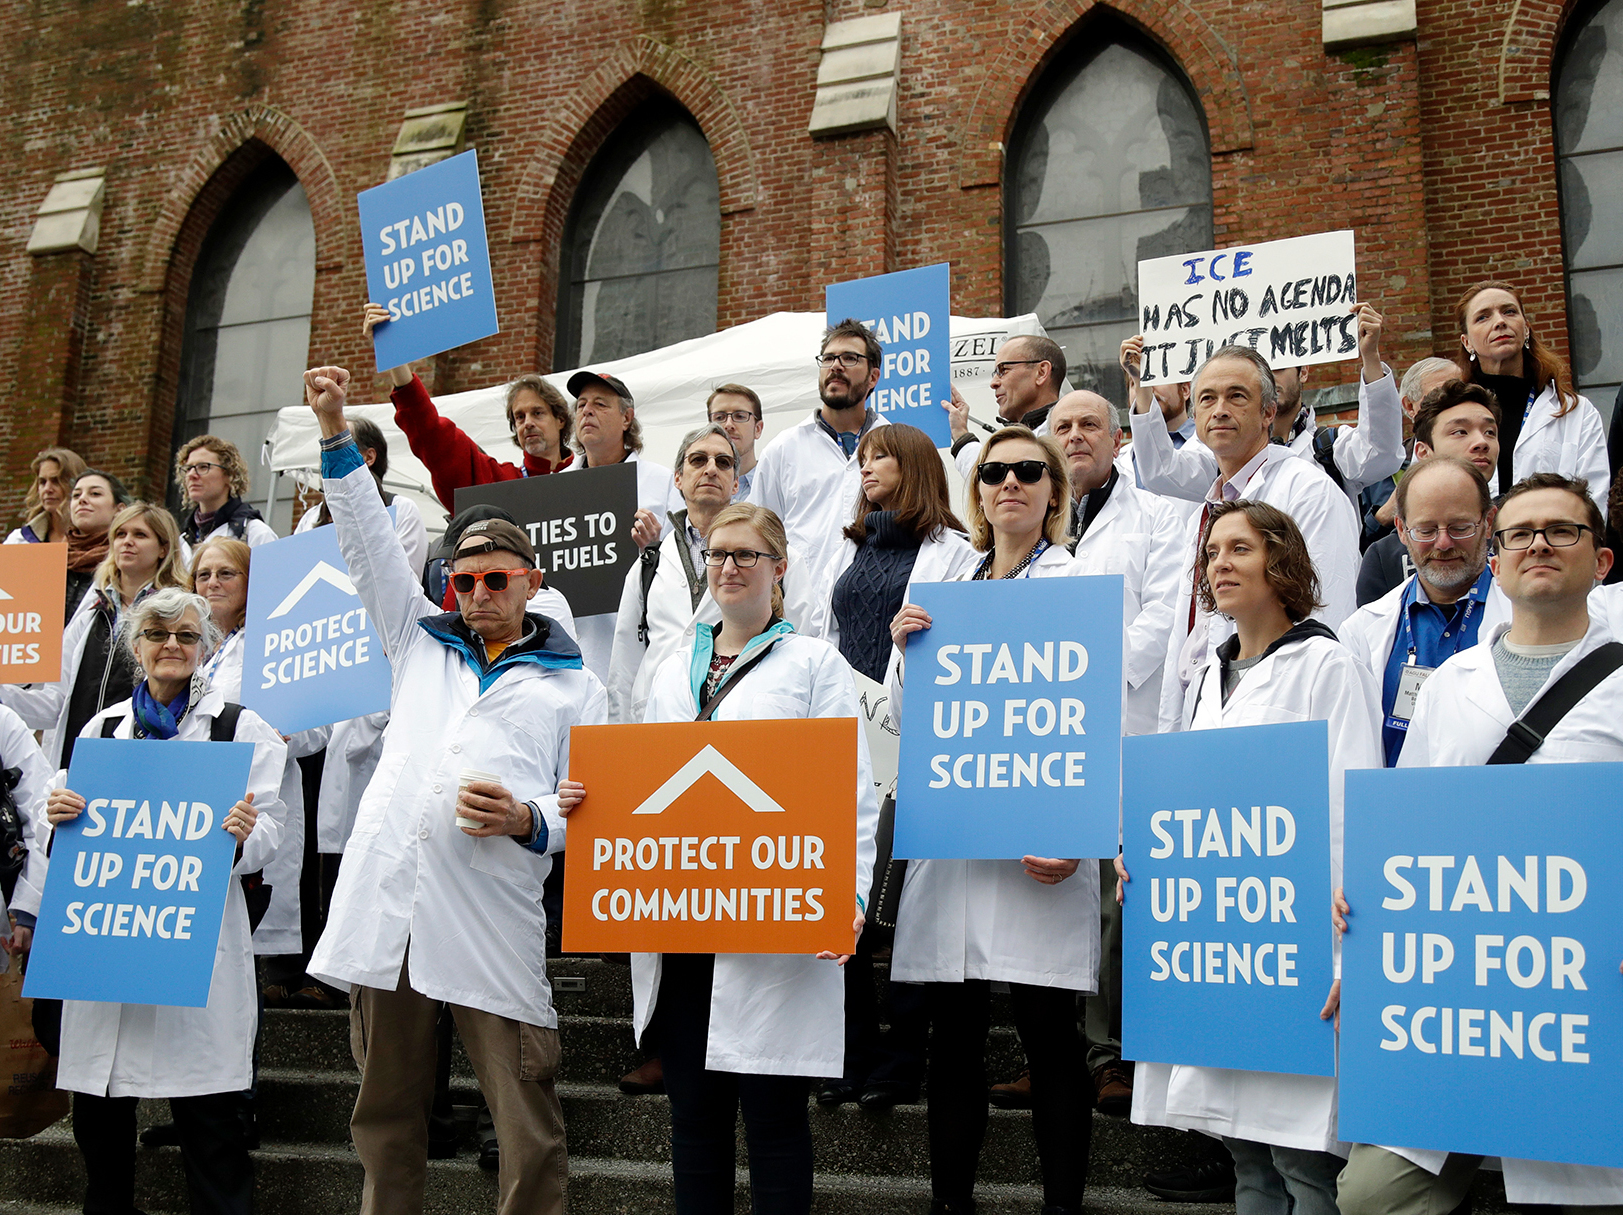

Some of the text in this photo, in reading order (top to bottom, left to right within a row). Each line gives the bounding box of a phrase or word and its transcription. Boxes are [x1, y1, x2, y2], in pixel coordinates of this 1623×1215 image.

[379, 202, 465, 256] STAND
[383, 238, 469, 290] UP FOR
[1182, 250, 1254, 286] ICE
[388, 271, 474, 322] SCIENCE
[1142, 272, 1356, 333] HAS NO AGENDA
[884, 348, 931, 379] FOR
[1140, 341, 1177, 382] IT
[1269, 313, 1358, 361] MELTS
[954, 366, 980, 379] 1887
[870, 382, 932, 413] IENCE
[526, 511, 617, 547] TIES TO
[552, 542, 618, 572] FUELS
[264, 607, 368, 658] PROTECT
[260, 636, 370, 690] SCIENCE
[934, 641, 1089, 685] STAND
[933, 700, 989, 739] UP
[1003, 698, 1086, 737] FOR
[928, 752, 1086, 788] SCIENCE
[81, 798, 214, 841] STAND
[1150, 806, 1297, 860] STAND
[73, 851, 203, 892] UP FOR
[593, 835, 826, 871] PROTECT OUR
[591, 887, 825, 922] COMMUNITIES
[1151, 876, 1298, 924] UP FOR
[1381, 854, 1588, 914] STAND
[61, 901, 196, 940] SCIENCE
[1150, 941, 1299, 987] SCIENCE
[1382, 932, 1588, 991] UP FOR
[1379, 1004, 1590, 1064] SCIENCE
